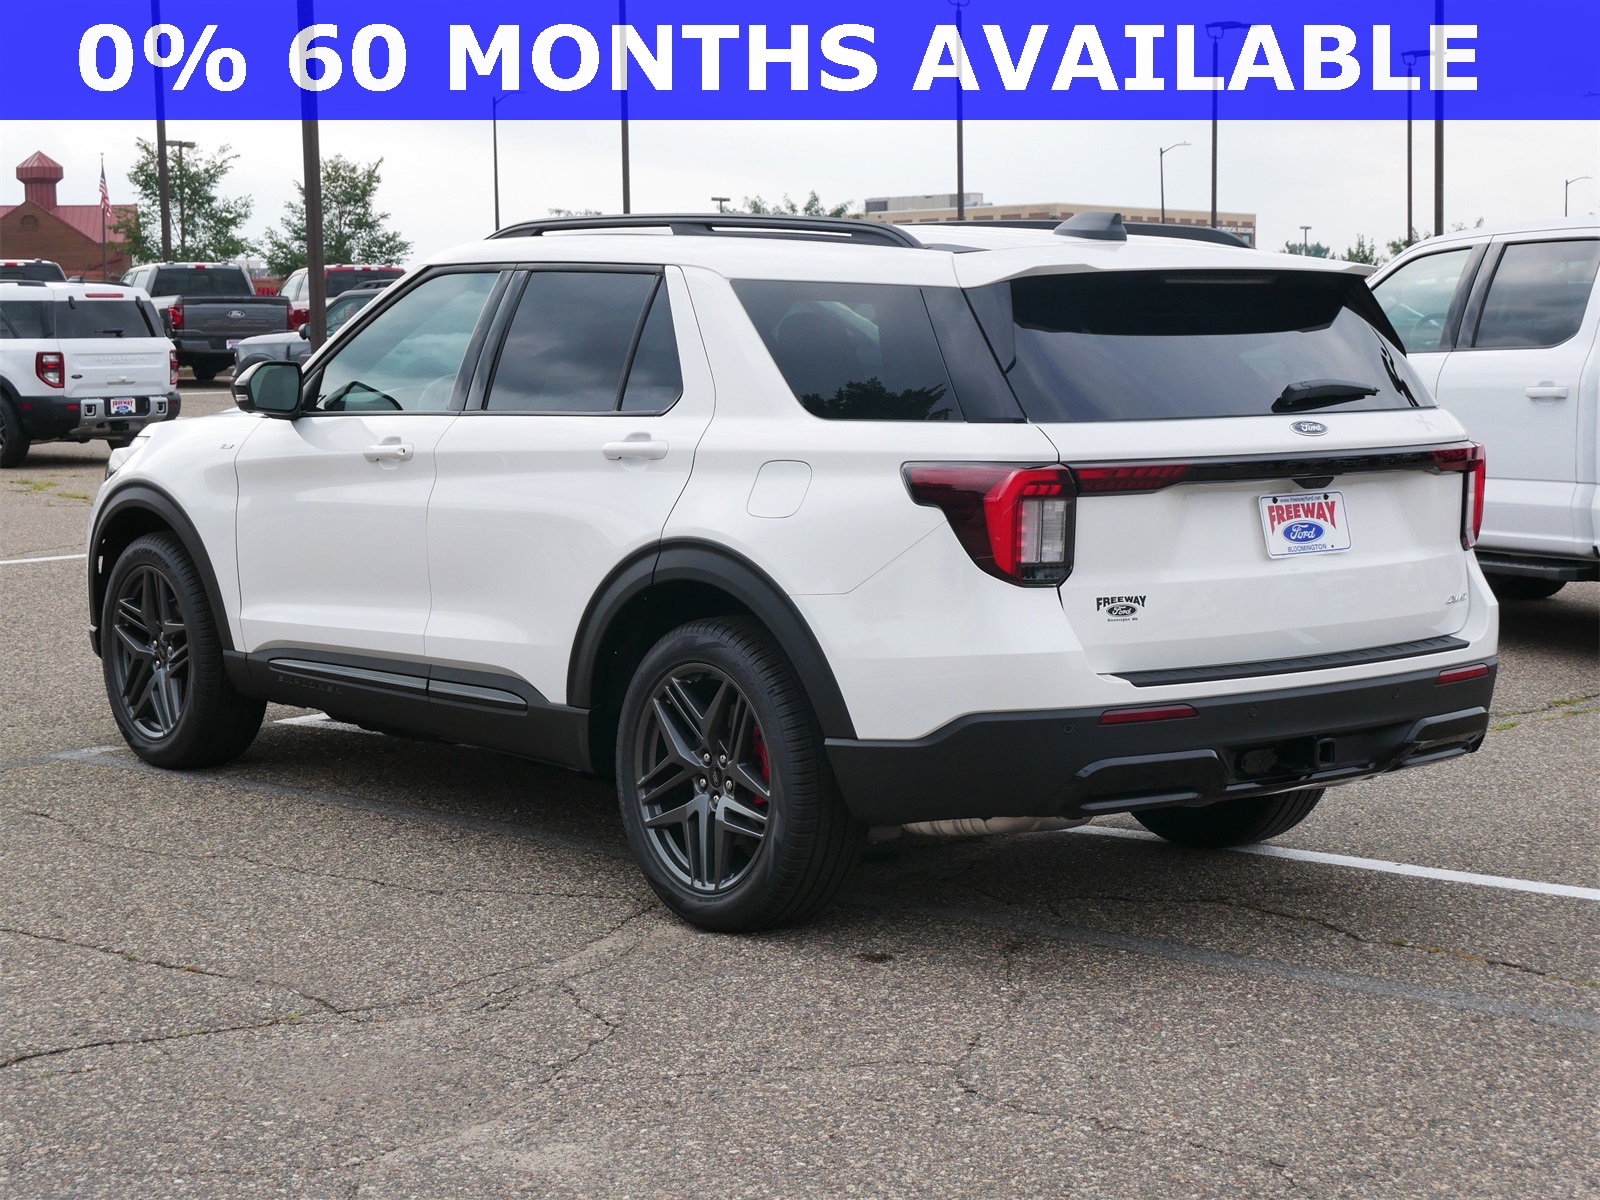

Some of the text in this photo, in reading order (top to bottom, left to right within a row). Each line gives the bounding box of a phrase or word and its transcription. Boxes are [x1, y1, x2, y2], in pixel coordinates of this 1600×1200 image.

[1300, 422, 1323, 432] Ford
[1268, 501, 1337, 535] FREEWAY
[1290, 524, 1317, 540] Ford
[1287, 543, 1327, 553] BLOOMINGTON
[133, 547, 171, 569] SCORPION
[1096, 595, 1147, 612] FREEWAY
[1112, 605, 1133, 615] Ford
